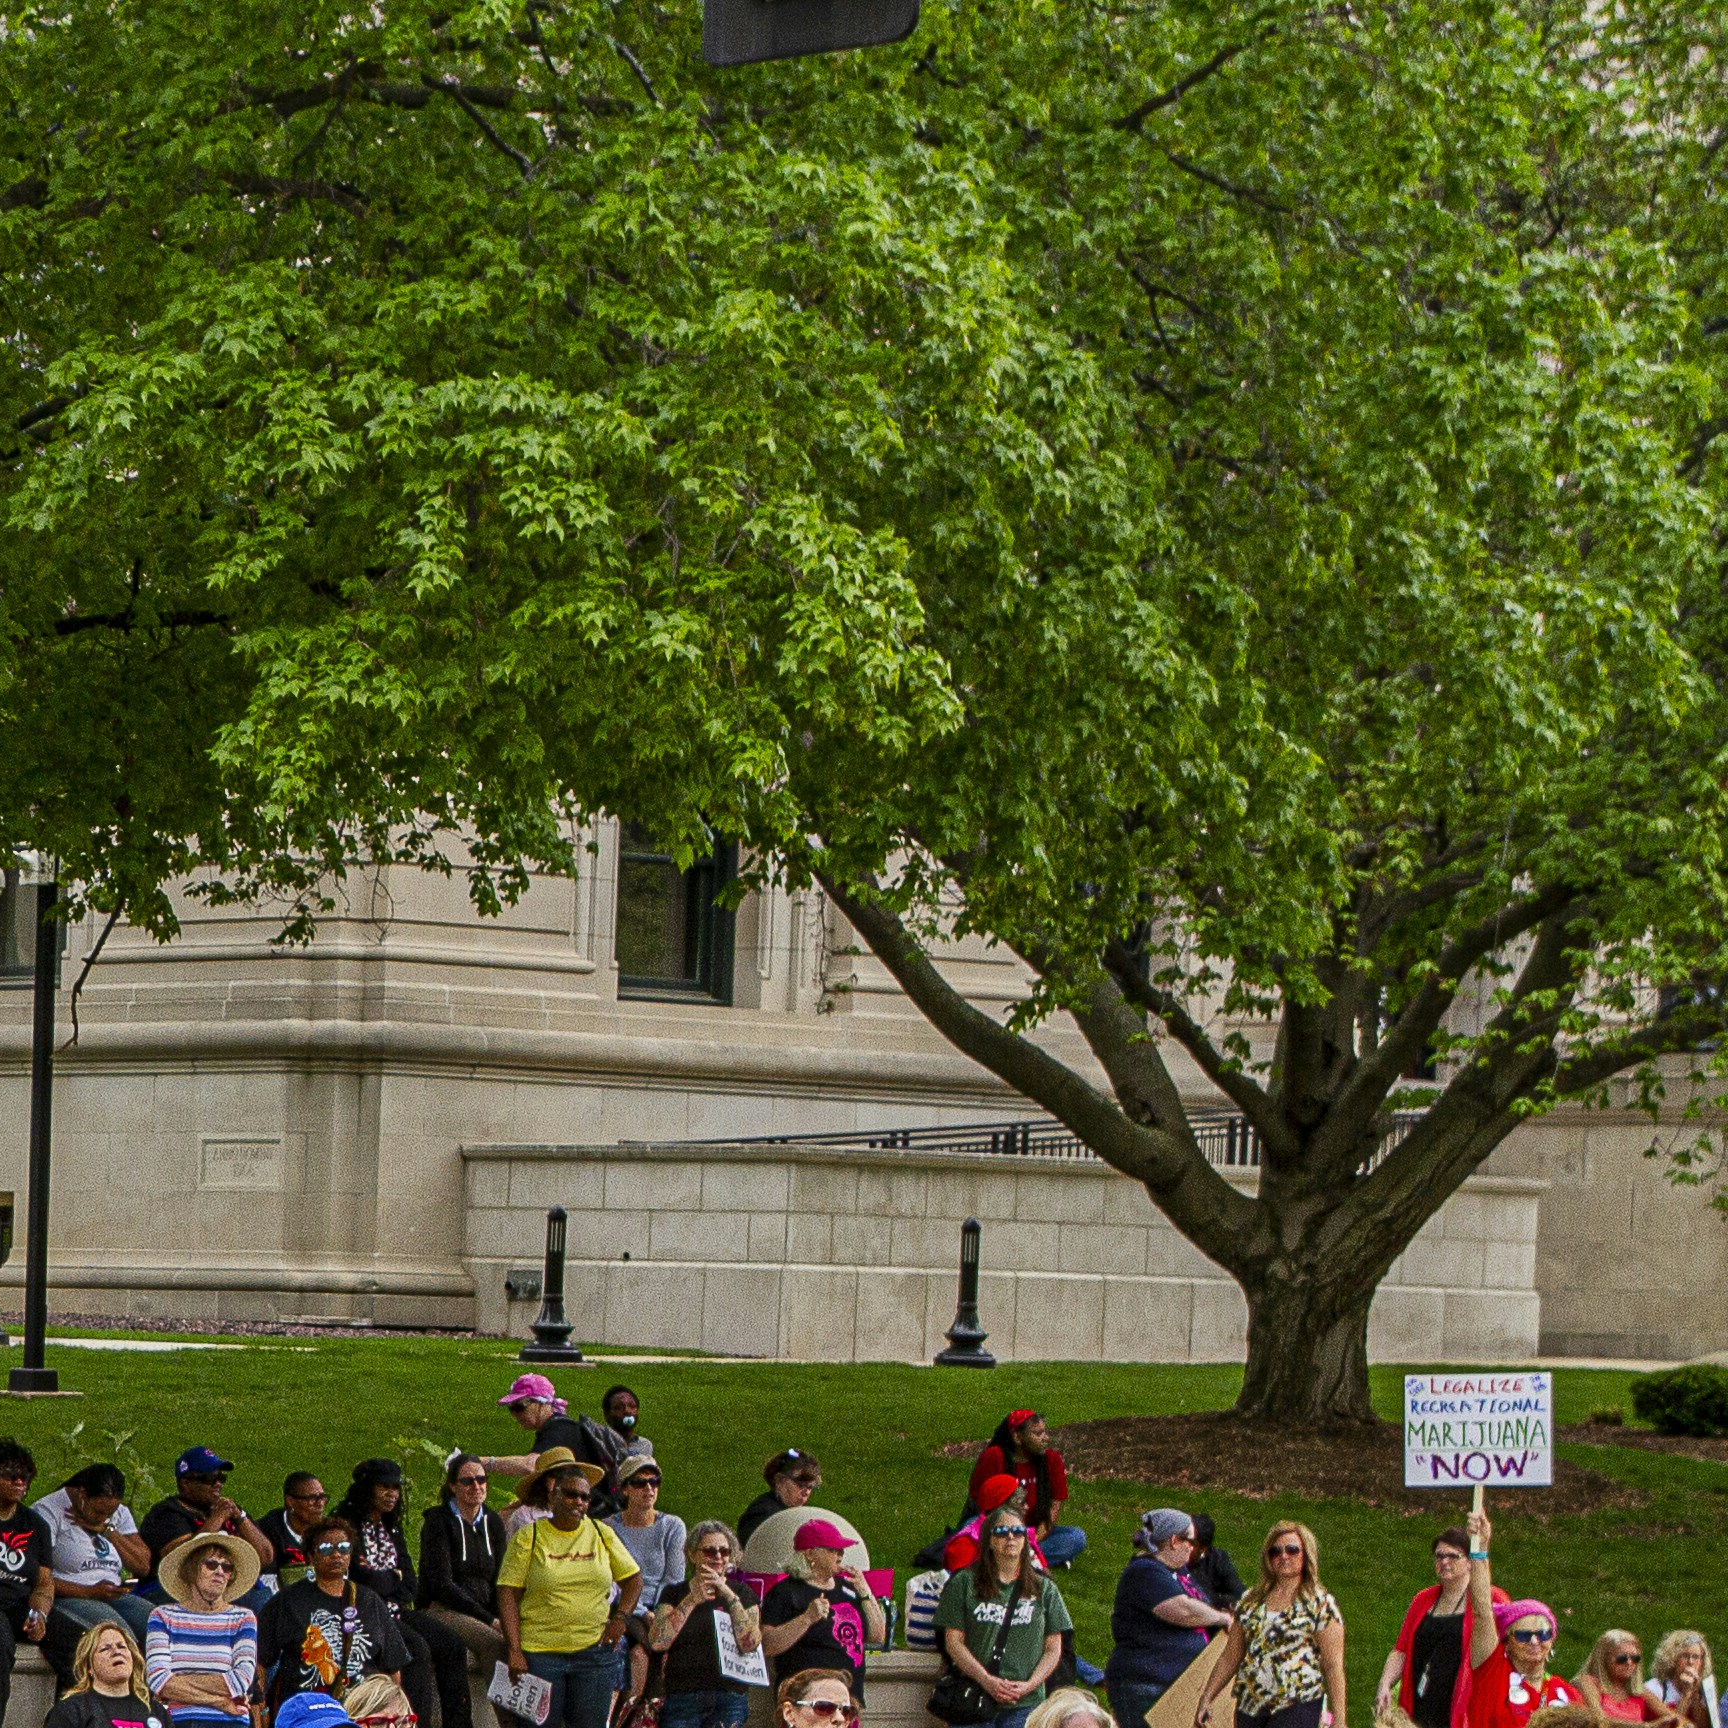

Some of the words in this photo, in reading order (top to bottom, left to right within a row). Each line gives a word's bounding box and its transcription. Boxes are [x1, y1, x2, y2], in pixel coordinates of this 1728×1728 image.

[1430, 1376, 1524, 1395] LEGALIZE
[1411, 1398, 1546, 1415] RECREATIONAL
[1407, 1416, 1546, 1448] MARIJUANA
